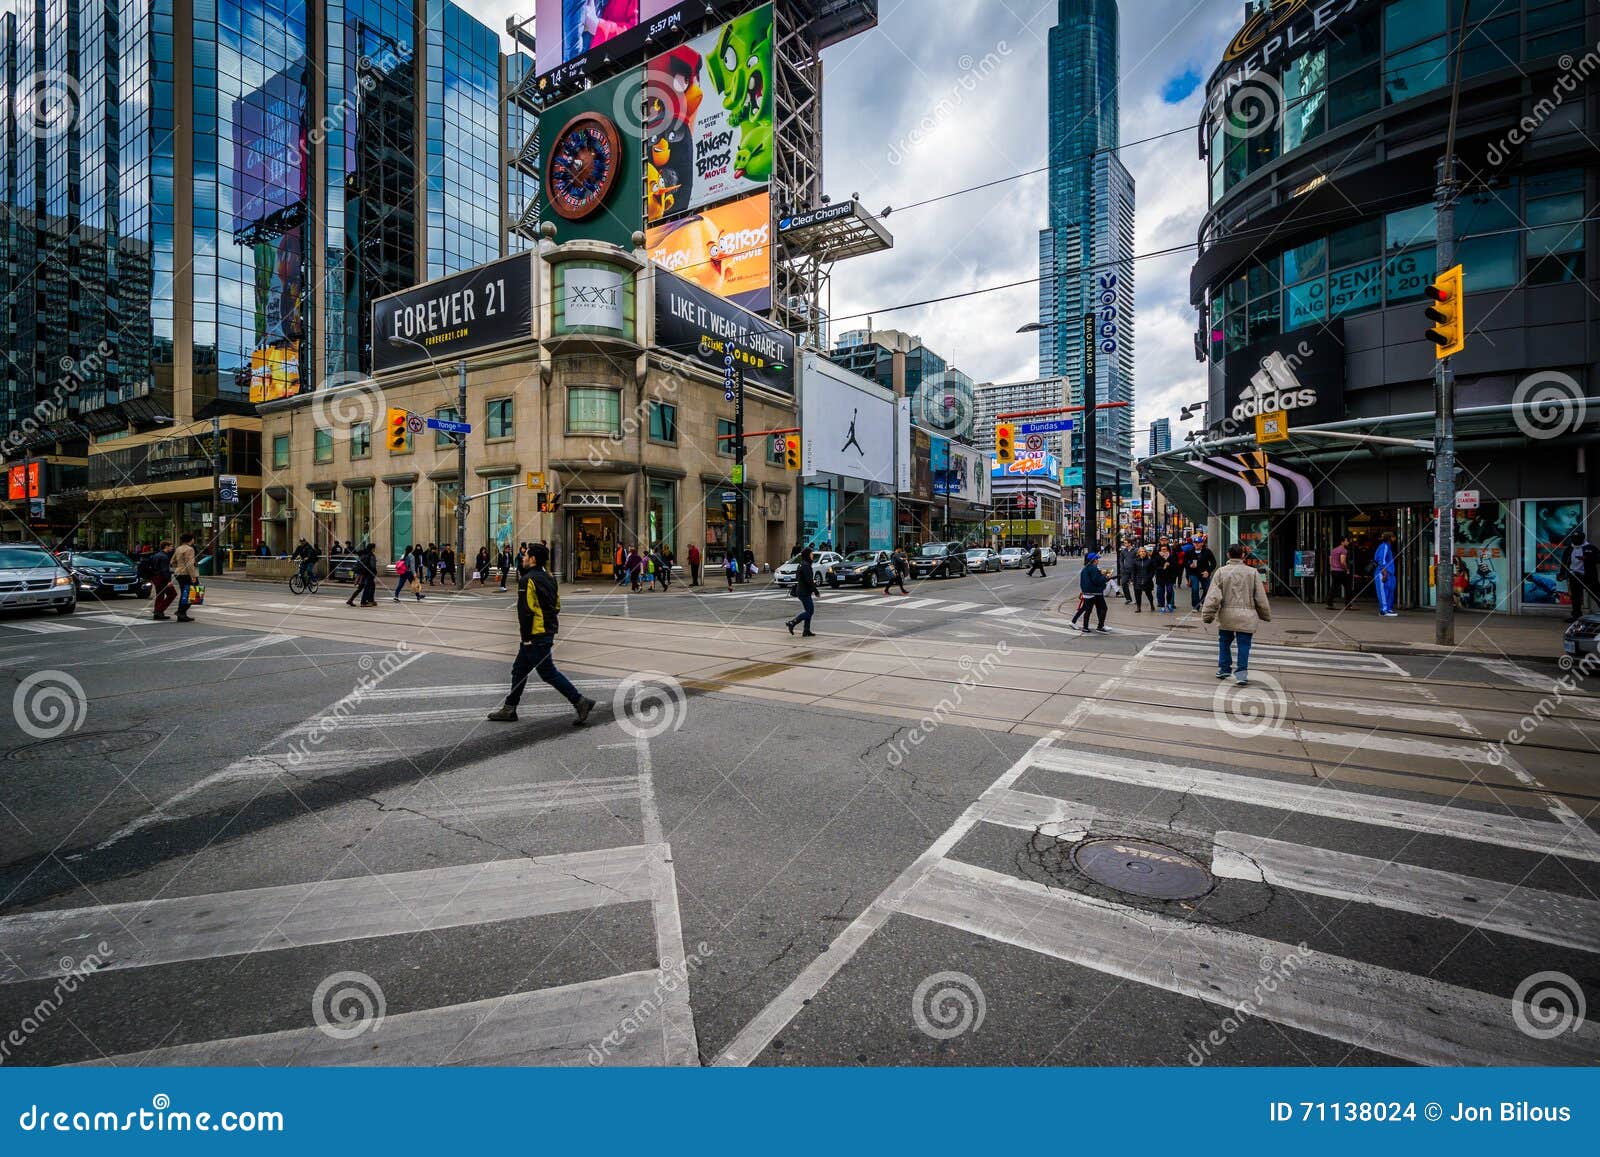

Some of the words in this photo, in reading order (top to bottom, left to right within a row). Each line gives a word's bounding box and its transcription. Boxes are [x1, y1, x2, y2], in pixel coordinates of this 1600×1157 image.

[650, 19, 667, 35] 5:57
[668, 11, 681, 26] PM
[696, 130, 733, 160] ANGRY
[703, 131, 712, 140] THE
[696, 149, 732, 177] BIRDS
[704, 166, 727, 180] MOVIE
[792, 214, 814, 227] Clear
[815, 202, 851, 219] Channel
[722, 223, 768, 254] BIRDS
[732, 248, 762, 262] MOVIE
[1309, 257, 1416, 298] OPENING
[571, 286, 617, 305] XXI
[394, 289, 476, 337] FOREVER
[485, 279, 505, 316] 21
[425, 328, 469, 346] FOREVER21.COM
[671, 293, 694, 323] LIKE
[697, 306, 708, 329] IT.
[709, 311, 736, 341] WEAR
[739, 325, 748, 347] IT.
[749, 331, 776, 359] SHARE
[777, 344, 785, 363] IT.
[1232, 389, 1317, 421] adidas
[438, 420, 457, 431] Yonge
[1030, 423, 1058, 431] Dundas
[580, 494, 607, 504] XXI
